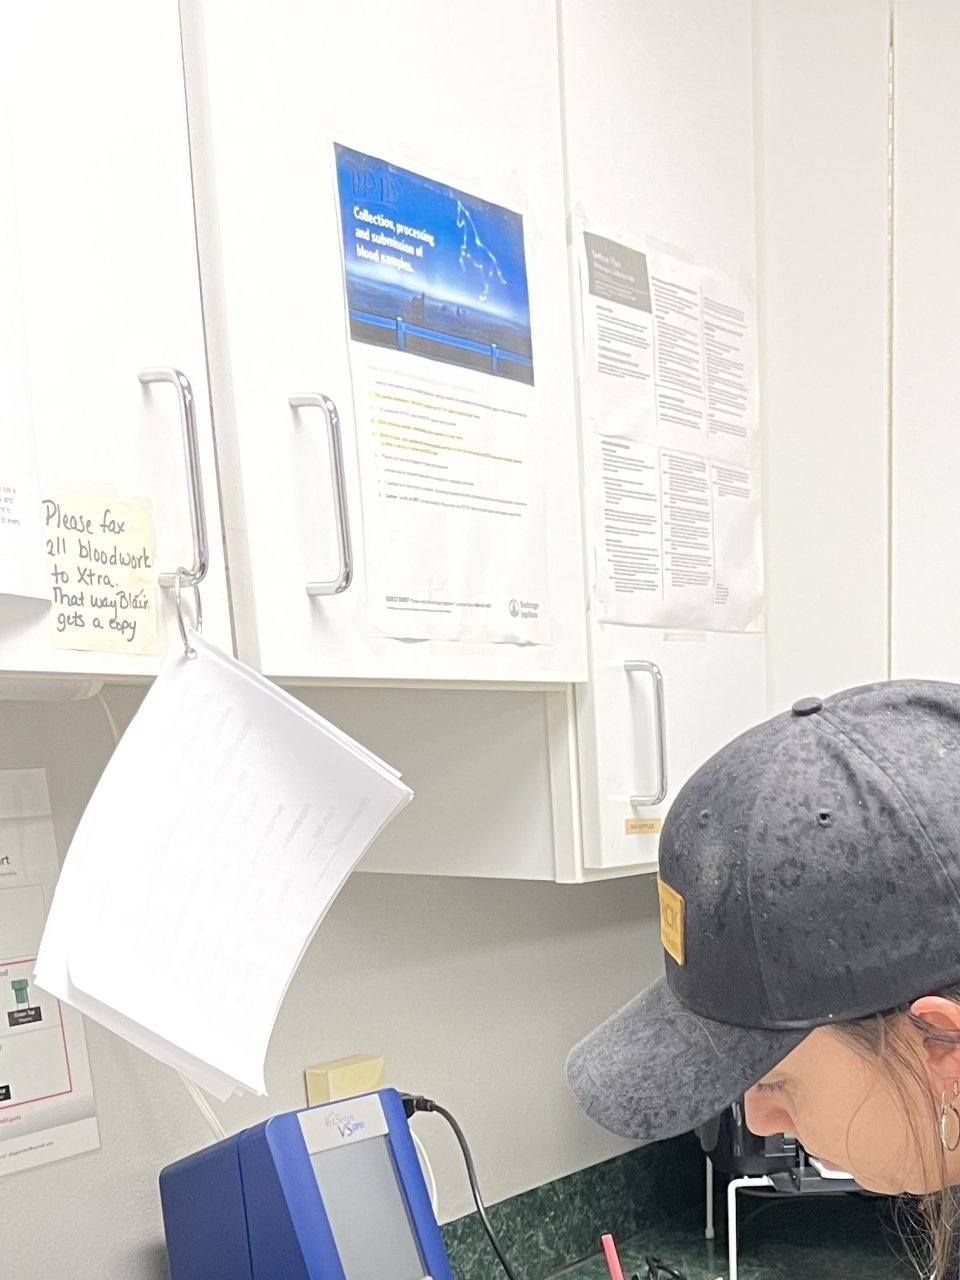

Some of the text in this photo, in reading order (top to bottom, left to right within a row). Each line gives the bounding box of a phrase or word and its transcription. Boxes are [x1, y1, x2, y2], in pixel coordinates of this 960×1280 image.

[353, 206, 435, 248] Collection, processing
[355, 227, 424, 258] and submission of
[356, 243, 380, 262] blood
[42, 499, 93, 534] Please
[100, 509, 125, 534] fax
[78, 538, 151, 570] bloodwork
[51, 564, 69, 584] to
[53, 586, 84, 606] That
[90, 594, 117, 619] way
[57, 611, 136, 642] gets a copy
